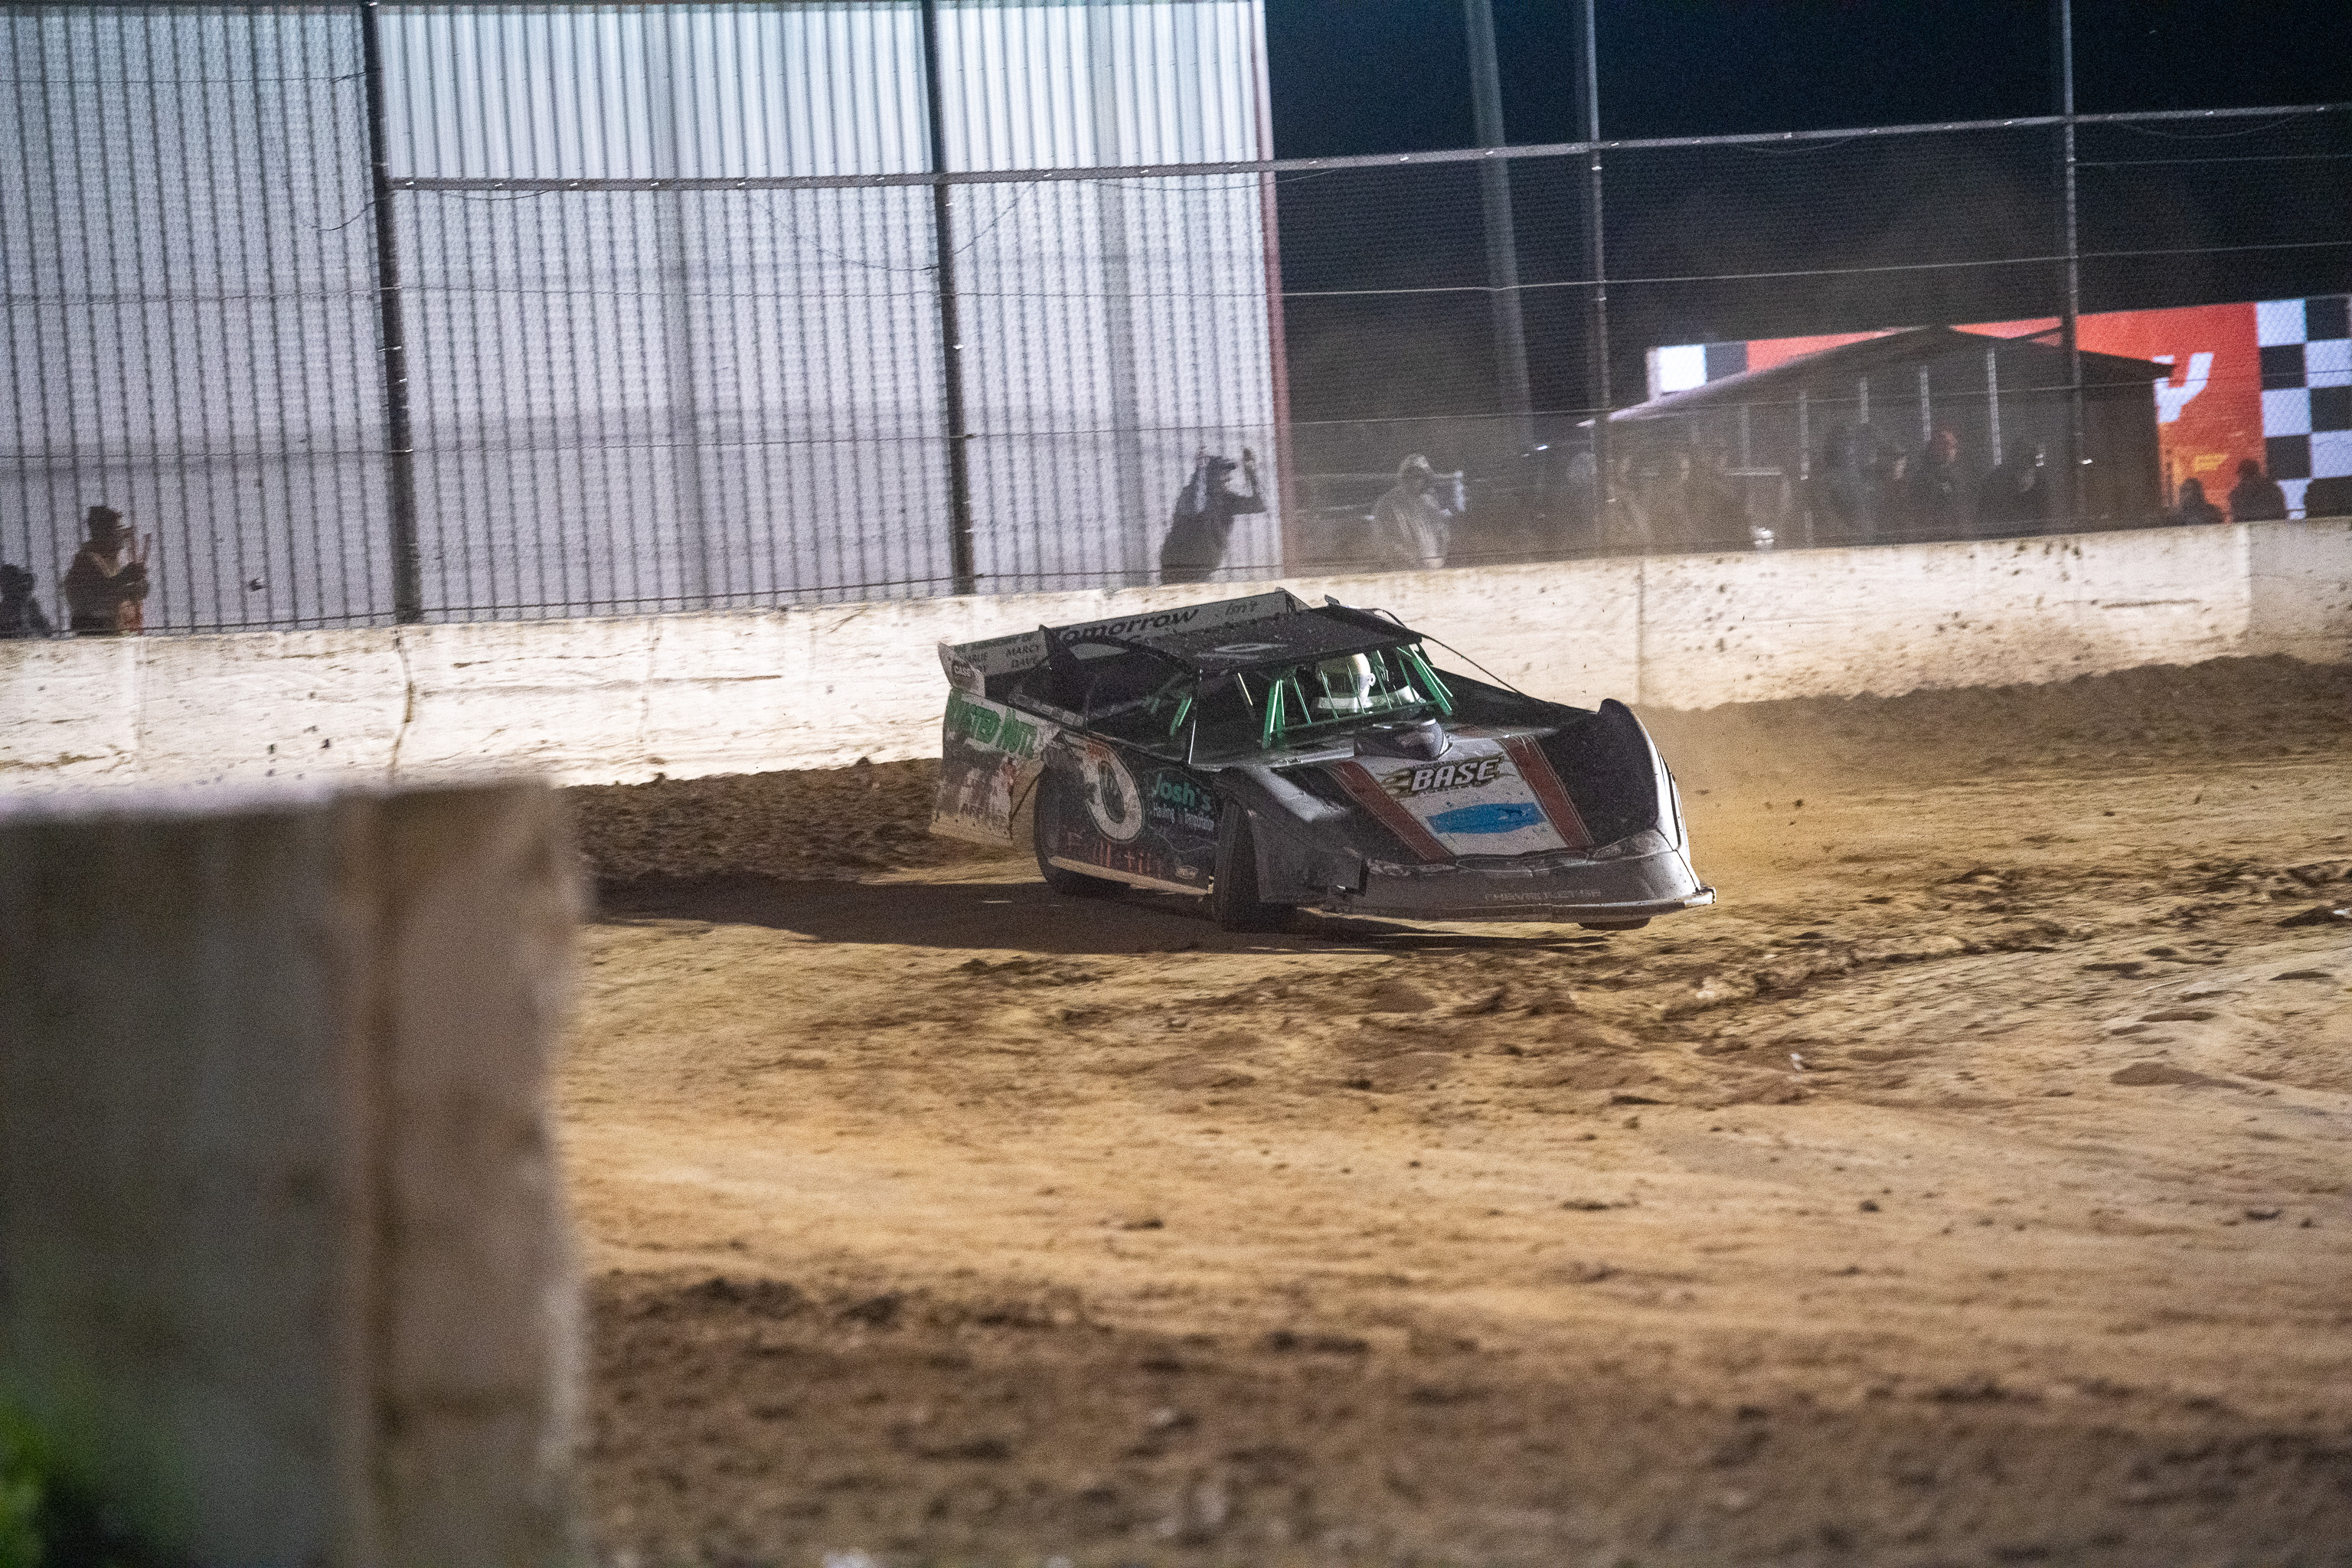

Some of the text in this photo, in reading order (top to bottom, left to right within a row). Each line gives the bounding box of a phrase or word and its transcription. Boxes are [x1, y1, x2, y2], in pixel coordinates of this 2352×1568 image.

[1057, 609, 1199, 642] Tomorrow
[1150, 772, 1212, 812] Josh's
[1411, 759, 1499, 792] BASE
